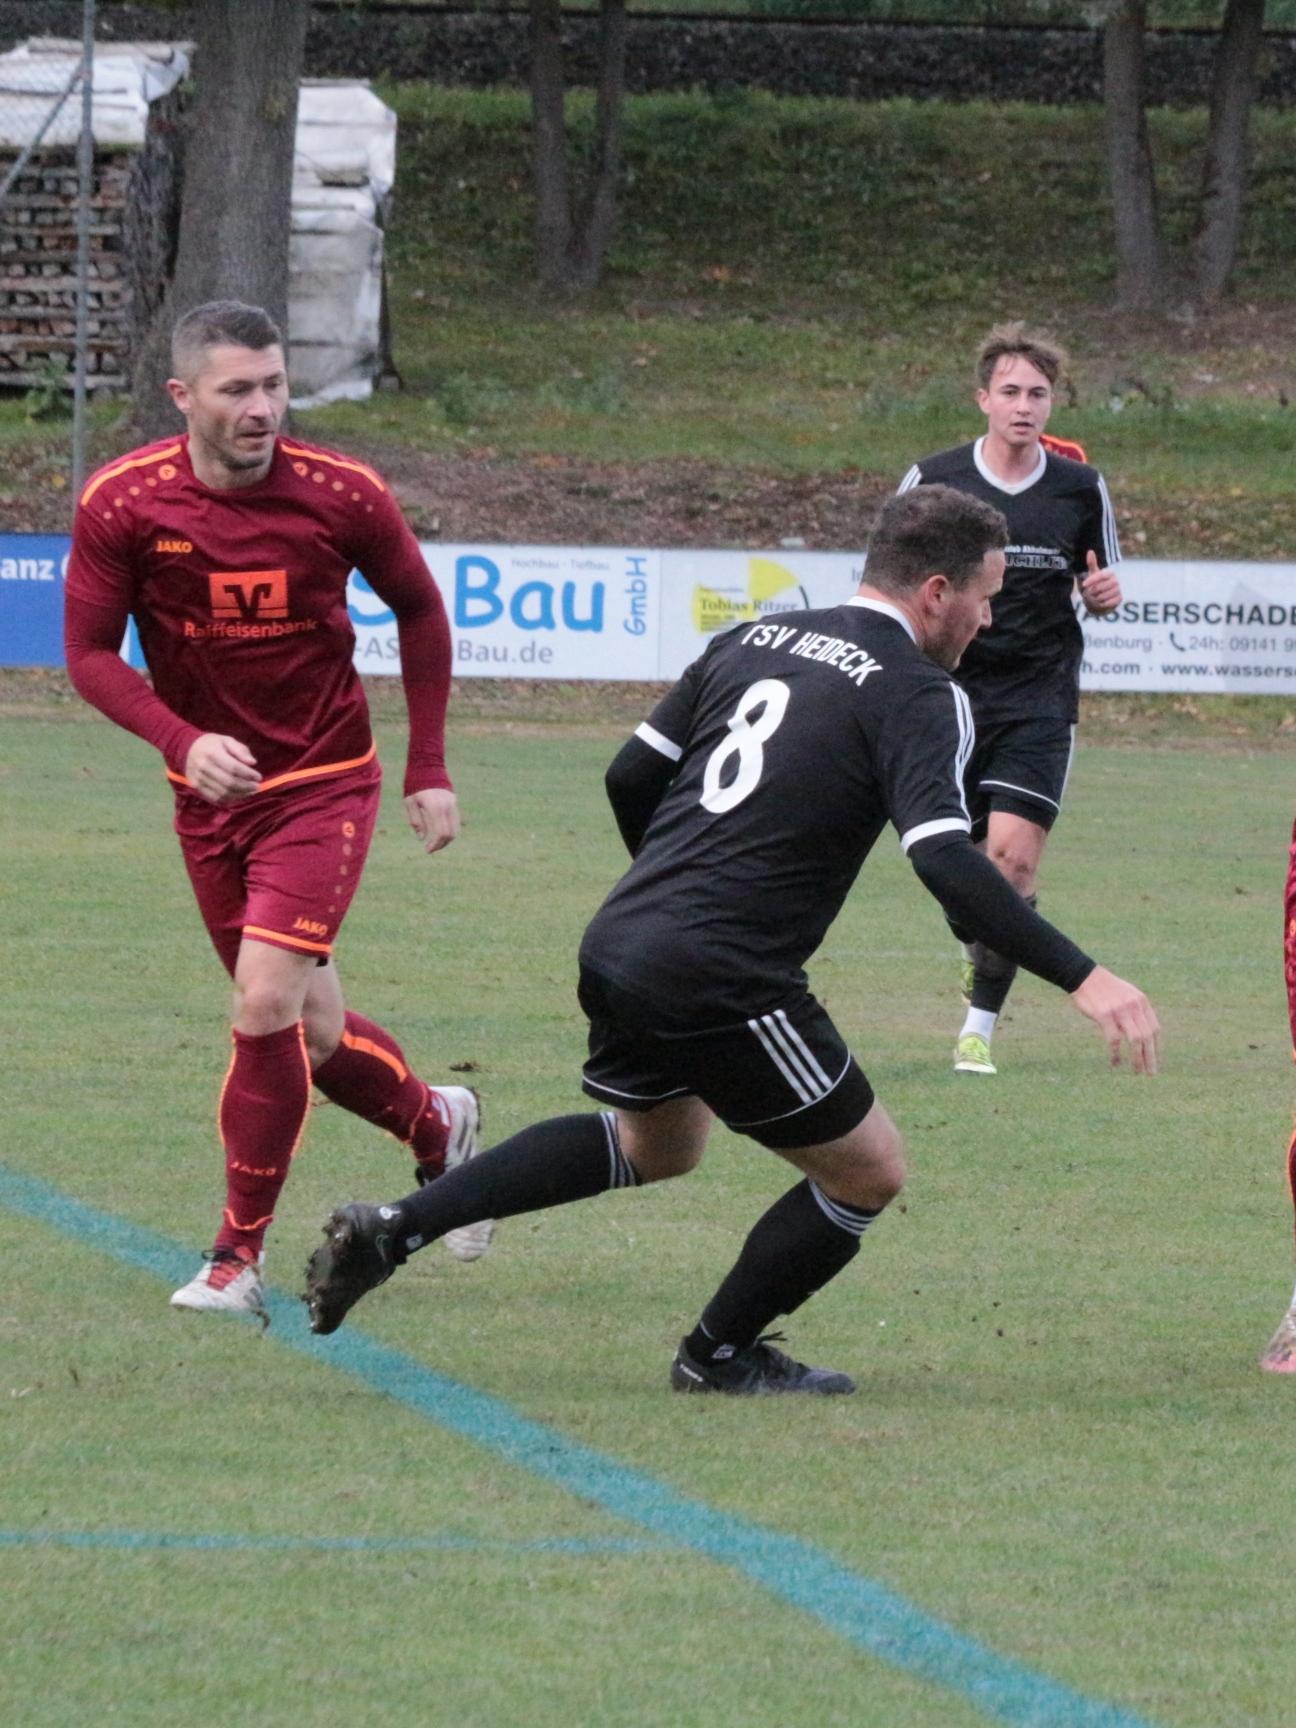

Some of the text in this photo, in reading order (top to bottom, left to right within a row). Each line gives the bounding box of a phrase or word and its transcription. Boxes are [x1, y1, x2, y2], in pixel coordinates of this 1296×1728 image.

[156, 540, 193, 553] JAKO
[454, 555, 605, 632] Bau
[624, 556, 647, 636] GmbH
[702, 597, 749, 612] Tobias
[184, 620, 317, 639] Raiffeisenbank
[741, 624, 884, 687] TSV HEIDECK
[699, 678, 791, 814] 8
[292, 917, 328, 936] JAKO
